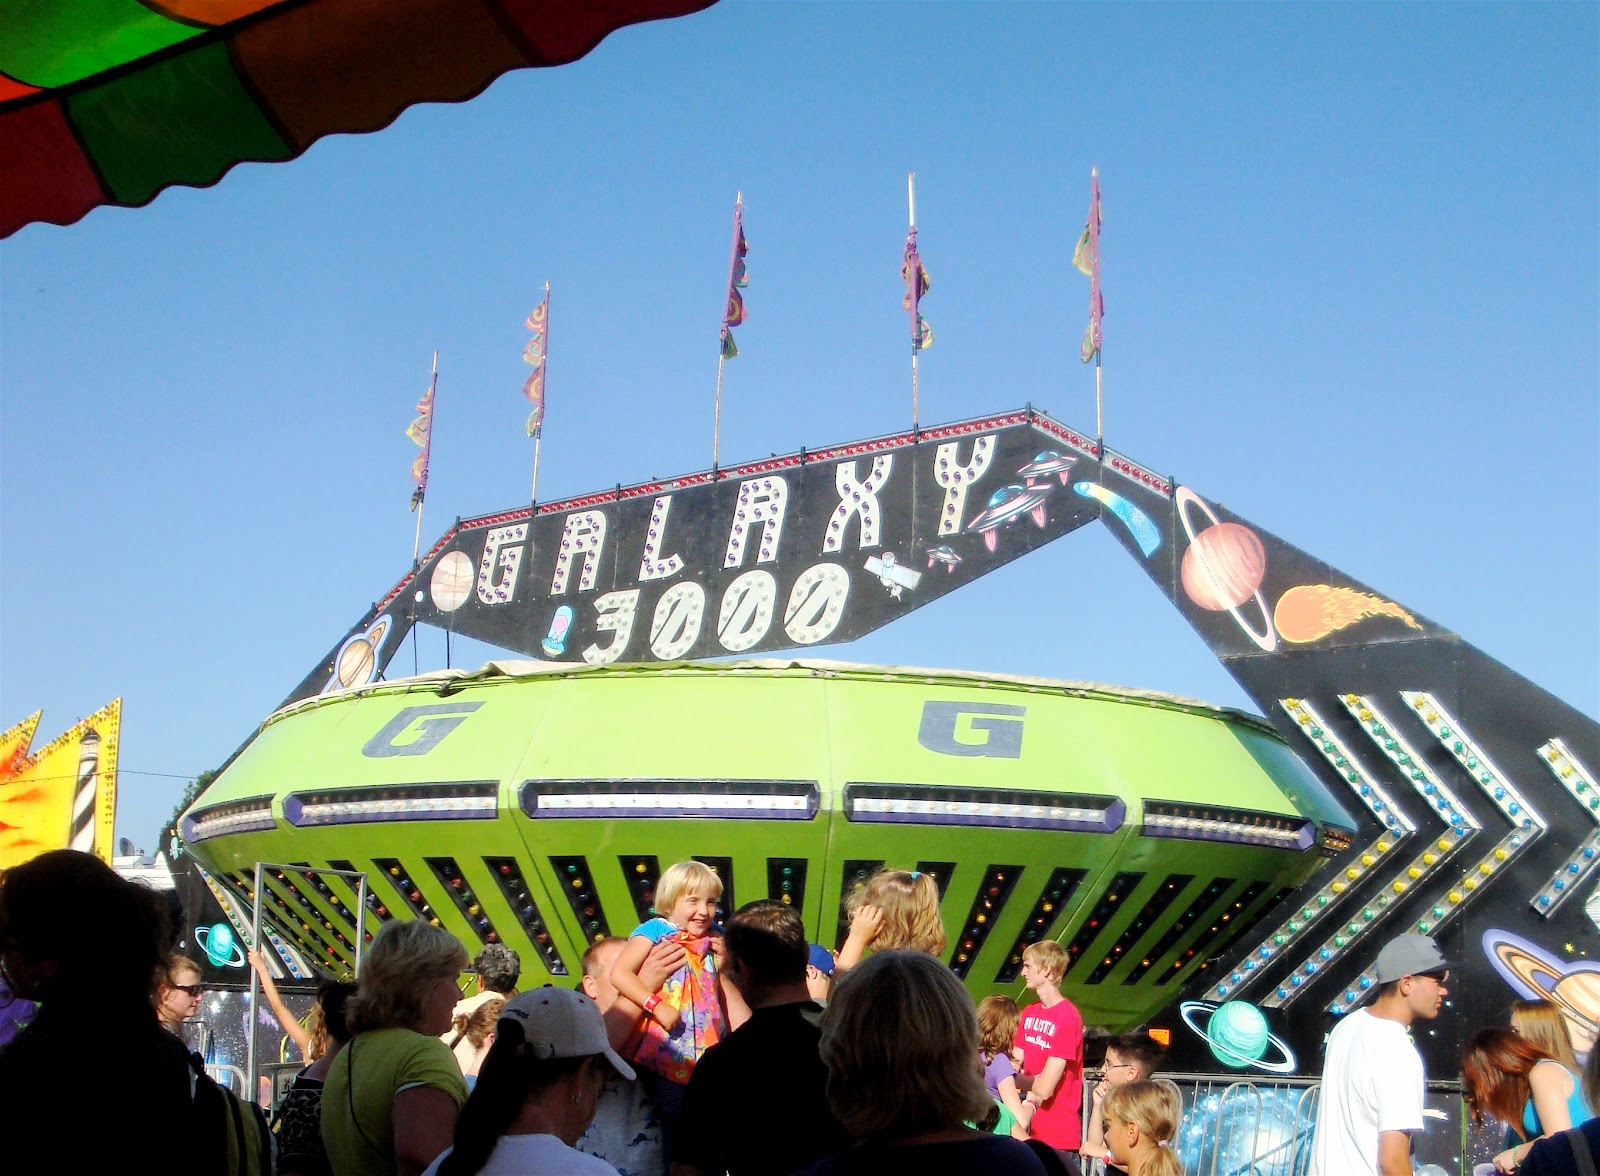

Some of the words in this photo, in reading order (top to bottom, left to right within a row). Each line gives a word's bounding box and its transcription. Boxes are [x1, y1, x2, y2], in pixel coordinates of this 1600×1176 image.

[475, 433, 997, 605] GALAXY
[581, 562, 850, 665] 3000
[360, 700, 487, 758] G
[917, 700, 1026, 759] G
